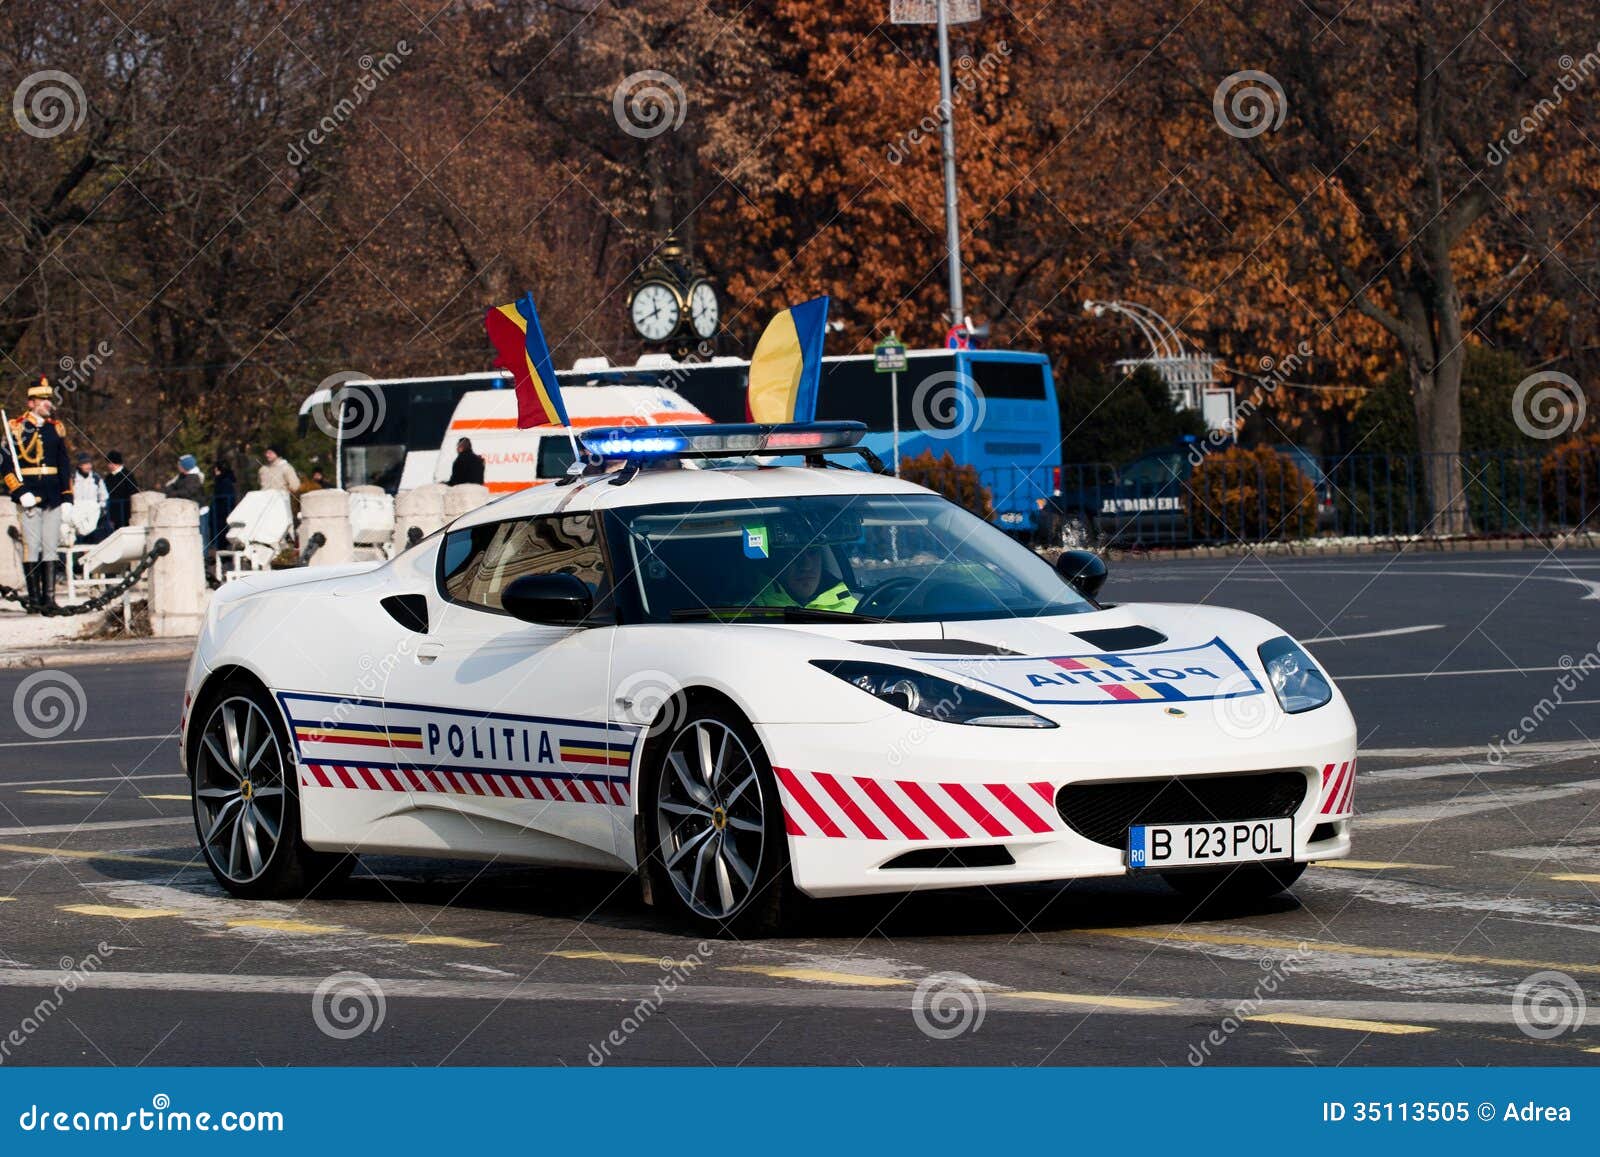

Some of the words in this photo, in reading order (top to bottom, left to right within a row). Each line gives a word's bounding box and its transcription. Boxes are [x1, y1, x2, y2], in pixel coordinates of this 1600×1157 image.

[427, 723, 554, 763] POLITIA
[1131, 849, 1145, 862] RO
[1151, 829, 1172, 860] B
[1184, 827, 1227, 859] 123
[1233, 822, 1282, 857] POL
